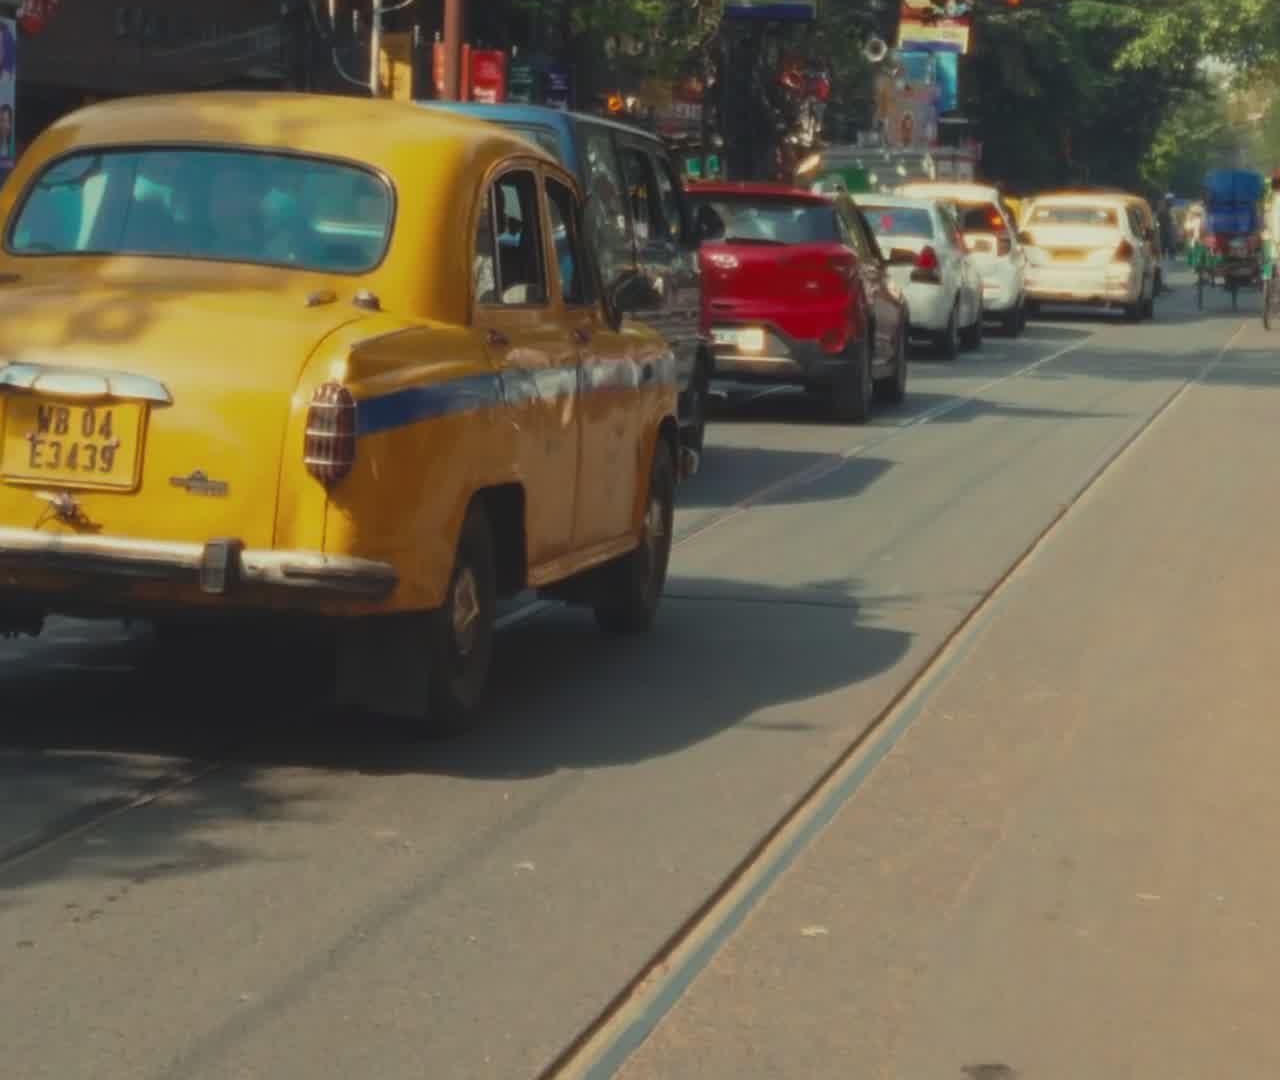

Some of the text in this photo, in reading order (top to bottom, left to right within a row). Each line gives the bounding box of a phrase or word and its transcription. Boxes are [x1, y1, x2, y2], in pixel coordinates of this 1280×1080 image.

[38, 404, 112, 439] WB 04
[29, 439, 115, 472] E3439
